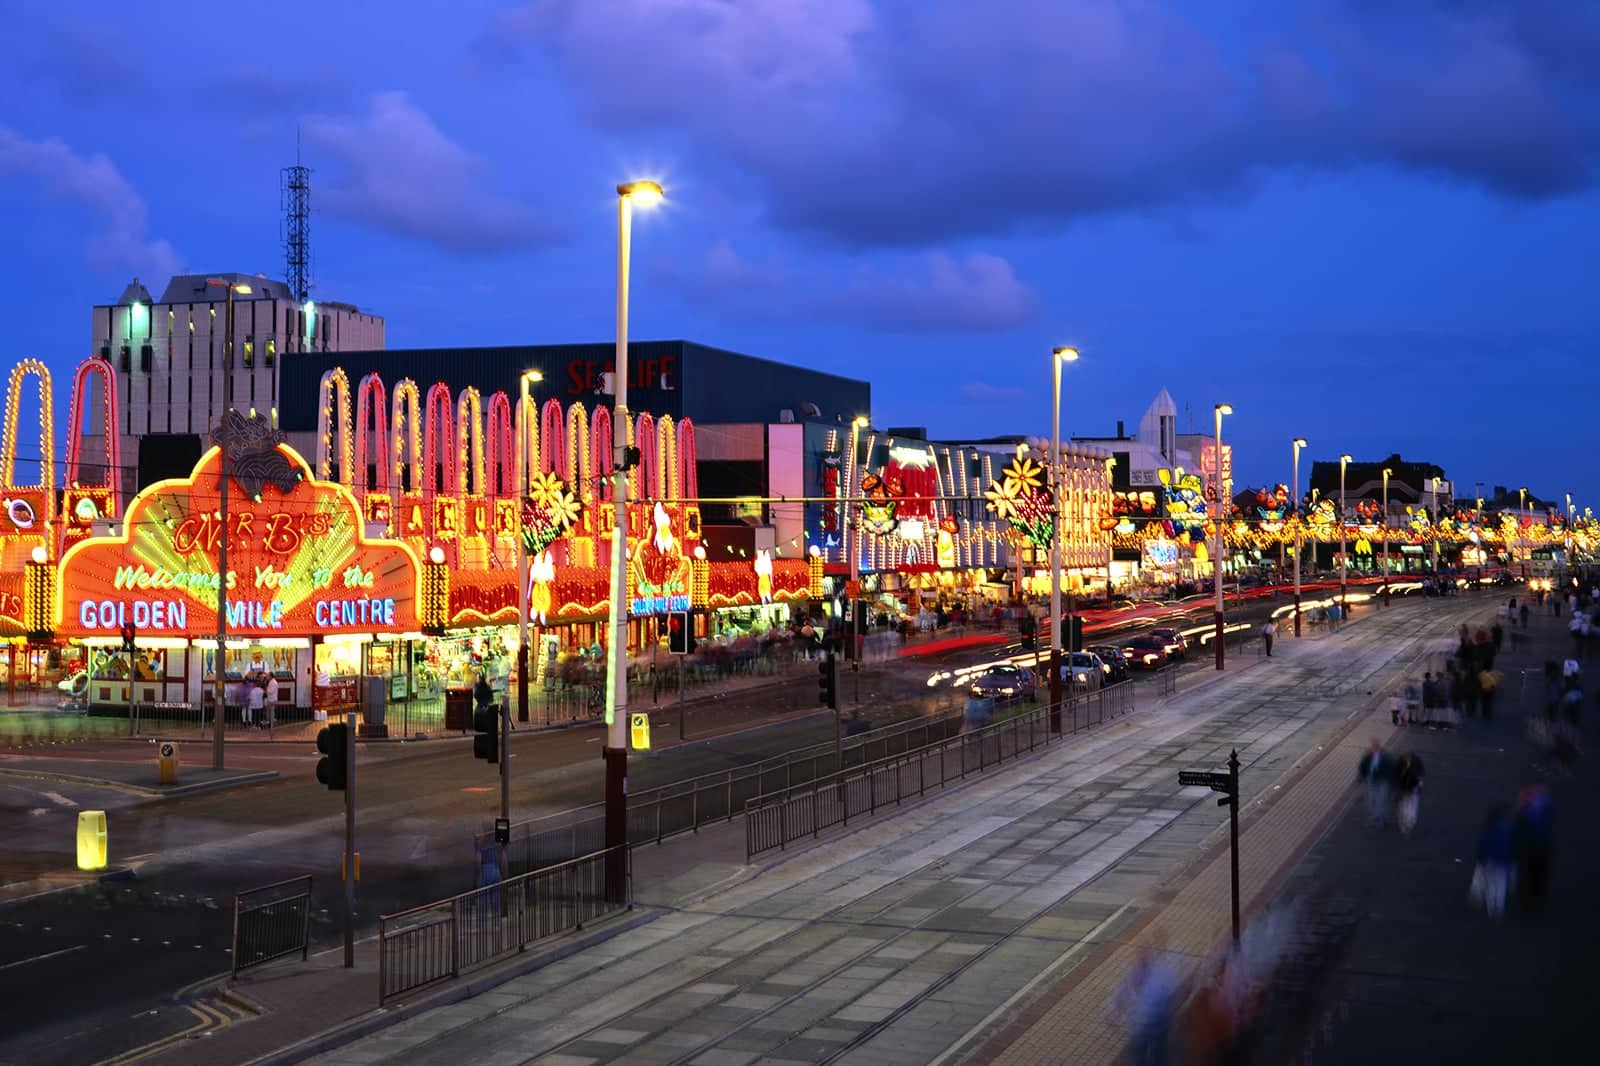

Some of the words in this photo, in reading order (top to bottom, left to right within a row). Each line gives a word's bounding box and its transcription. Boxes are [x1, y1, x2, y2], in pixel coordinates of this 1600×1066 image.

[114, 564, 238, 591] Welcomes
[255, 564, 293, 590] You
[313, 567, 332, 590] to
[343, 564, 374, 589] the
[315, 598, 395, 627] CENTRE
